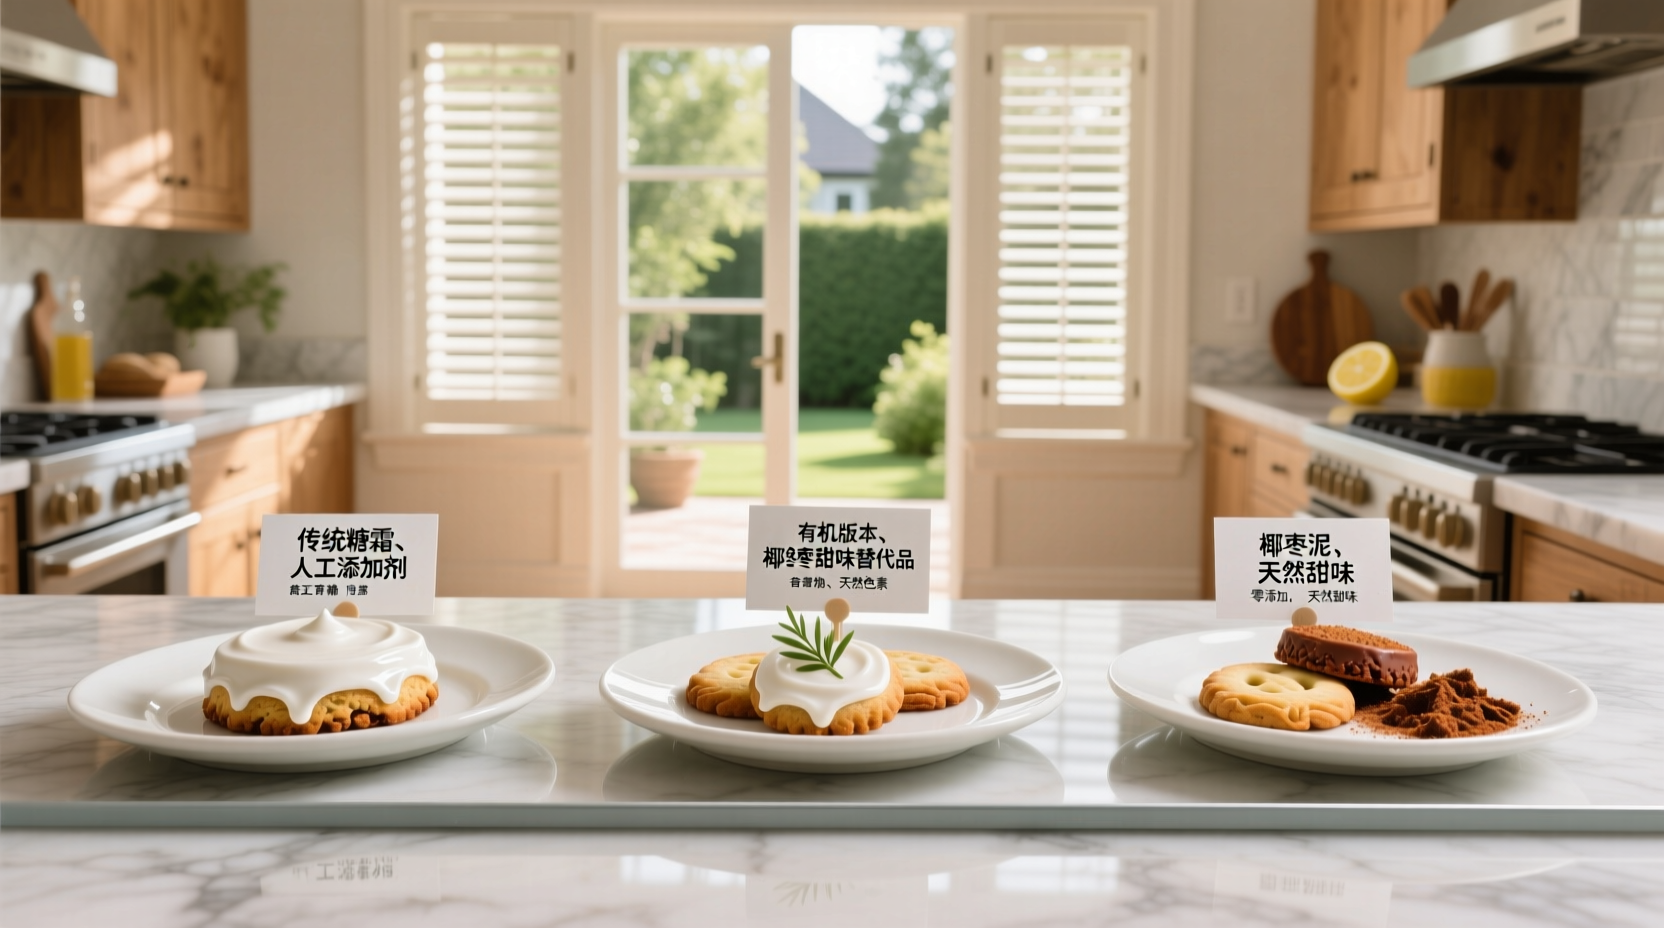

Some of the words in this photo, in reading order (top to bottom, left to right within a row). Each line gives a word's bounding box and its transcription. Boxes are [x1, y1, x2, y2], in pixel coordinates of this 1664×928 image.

[297, 526, 404, 553] 传统糖霜、
[797, 520, 886, 543] 有机版本、
[1259, 532, 1342, 558] 椰枣泥、
[290, 555, 407, 580] 人工添加剂
[1258, 560, 1355, 585] 天然甜味
